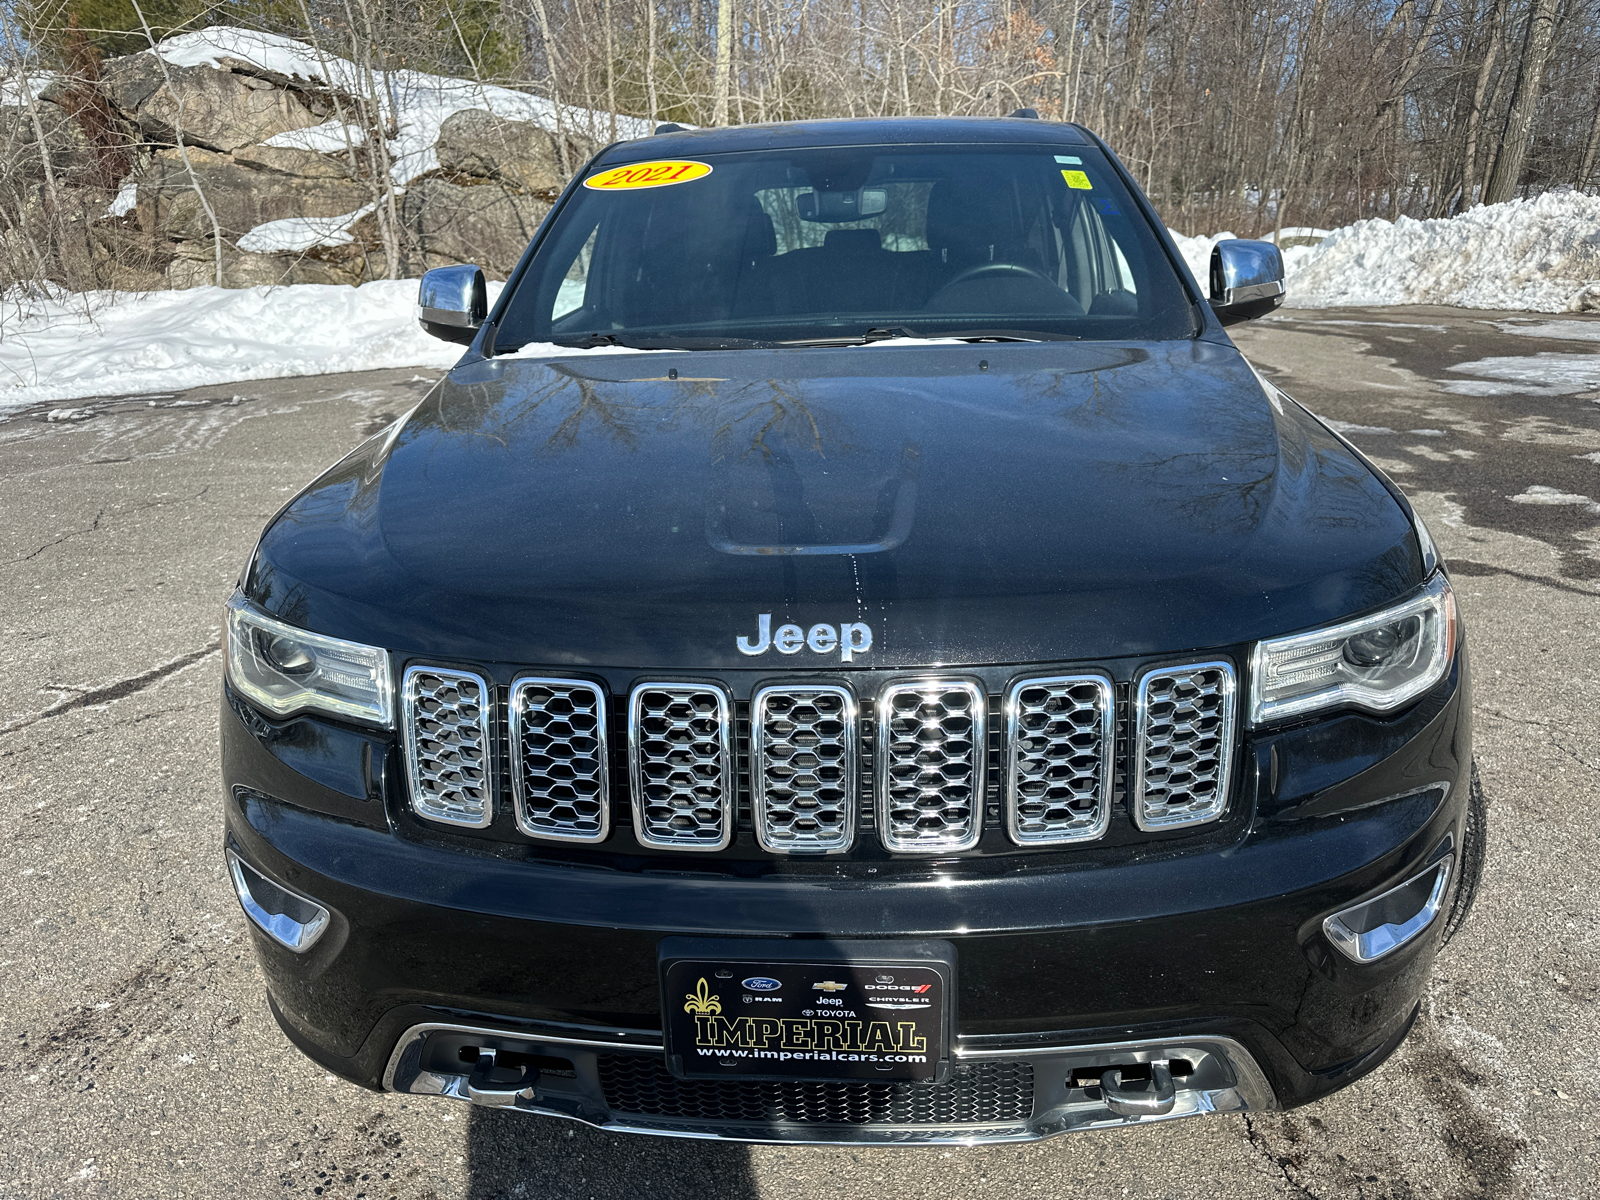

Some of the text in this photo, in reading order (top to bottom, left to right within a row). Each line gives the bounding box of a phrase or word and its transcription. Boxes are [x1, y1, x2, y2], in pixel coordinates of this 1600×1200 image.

[600, 165, 693, 186] 2021
[736, 613, 873, 662] Jeep
[750, 979, 773, 989] Ford
[816, 997, 843, 1007] Jeep
[816, 1009, 856, 1018] TOYOTA
[695, 1015, 927, 1053] IMPERIAL
[697, 1048, 927, 1063] www.imperialcars.com
